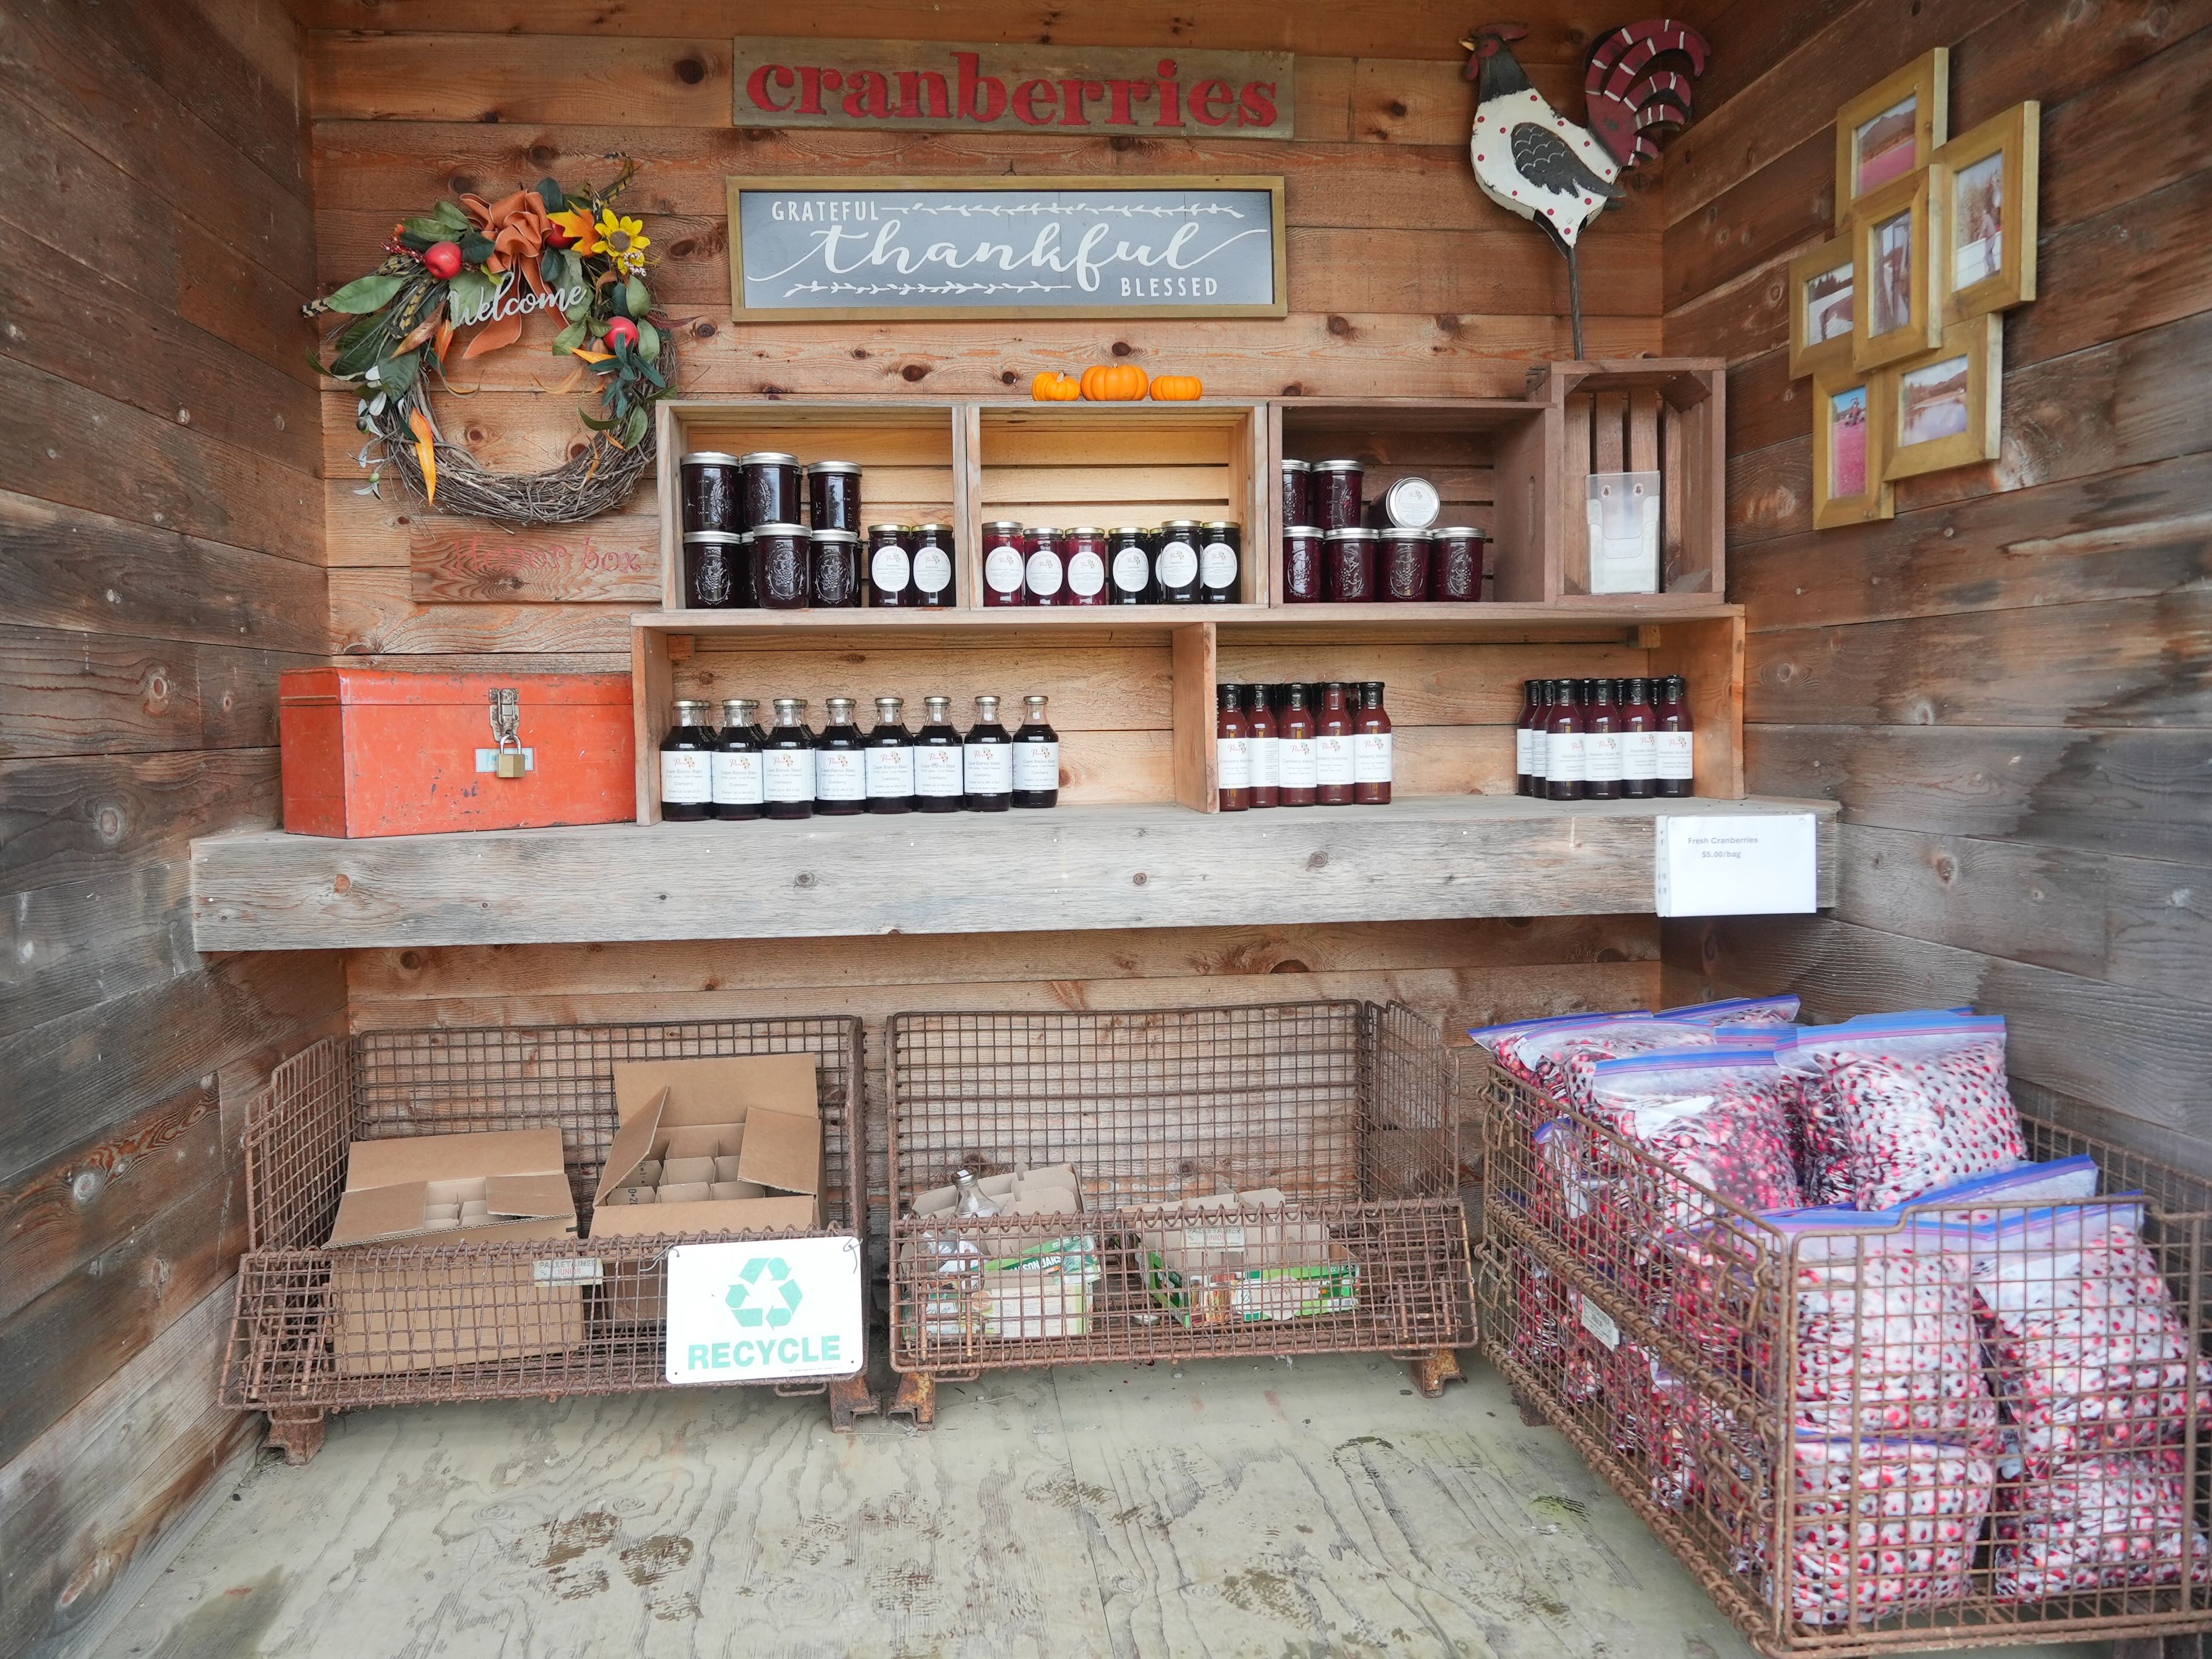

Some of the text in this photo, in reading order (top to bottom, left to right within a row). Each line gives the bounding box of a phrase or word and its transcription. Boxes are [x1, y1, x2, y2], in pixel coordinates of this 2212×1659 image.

[746, 51, 1278, 127] cranberries
[772, 200, 880, 223] GRATEFUL
[747, 219, 1268, 292] thankful
[1120, 276, 1218, 297] BLESSED
[450, 536, 641, 578] Honor box
[1701, 851, 1742, 859] $5.00/bag
[558, 1267, 581, 1275] JUNIOR
[1042, 1255, 1061, 1268] JARS
[688, 1335, 841, 1370] RECYCLE
